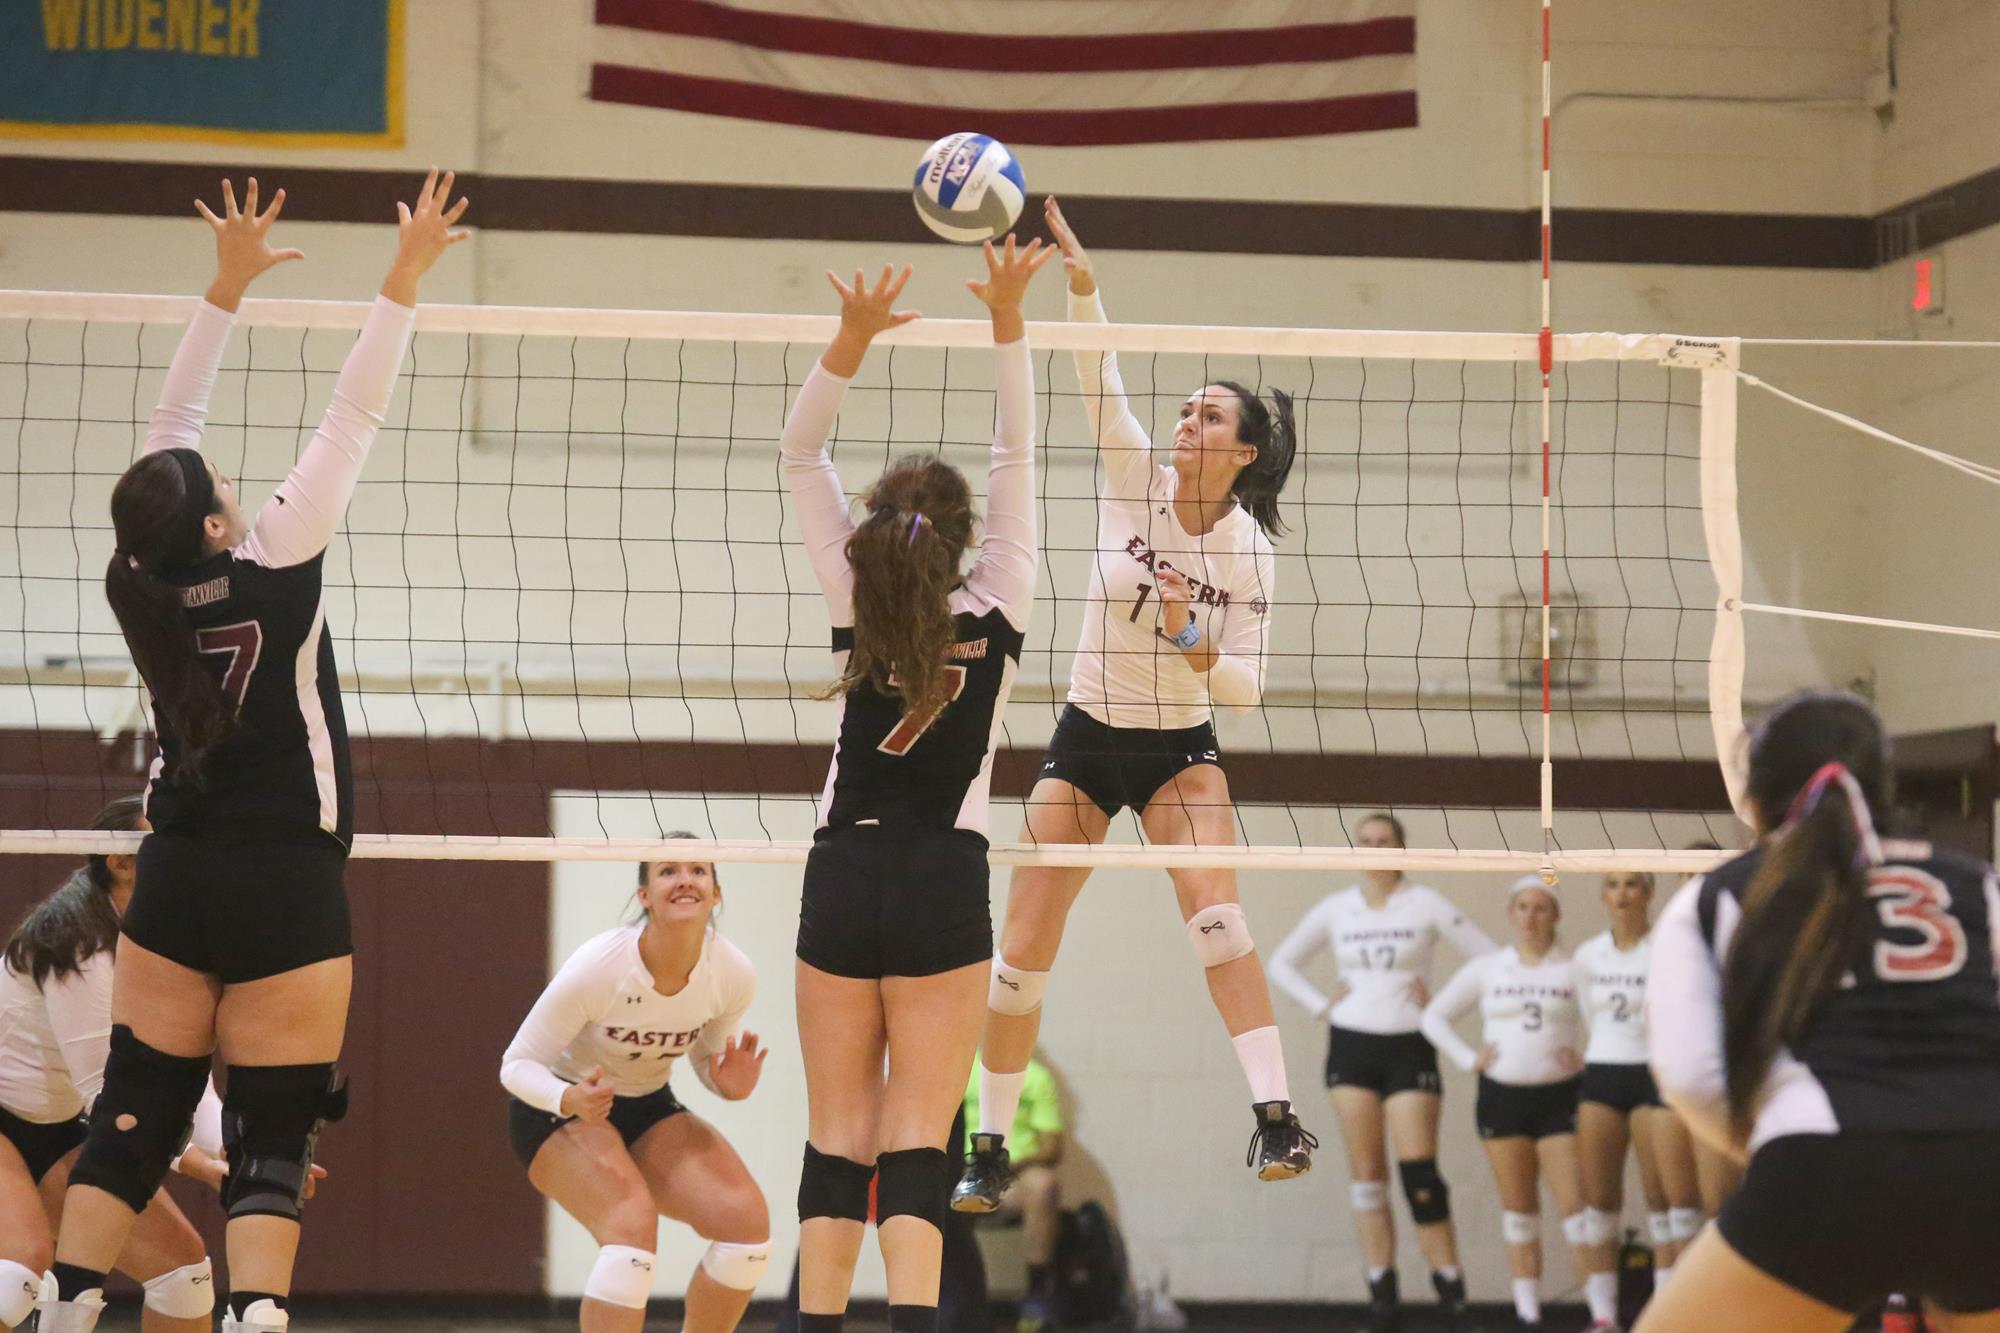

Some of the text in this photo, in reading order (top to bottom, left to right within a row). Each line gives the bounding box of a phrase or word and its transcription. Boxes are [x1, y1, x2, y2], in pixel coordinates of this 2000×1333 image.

[42, 0, 260, 57] WIDENER
[1839, 865, 1969, 990] 3
[1523, 1002, 1542, 1031] 3
[1610, 992, 1630, 1022] 2
[604, 1022, 706, 1047] EASTER
